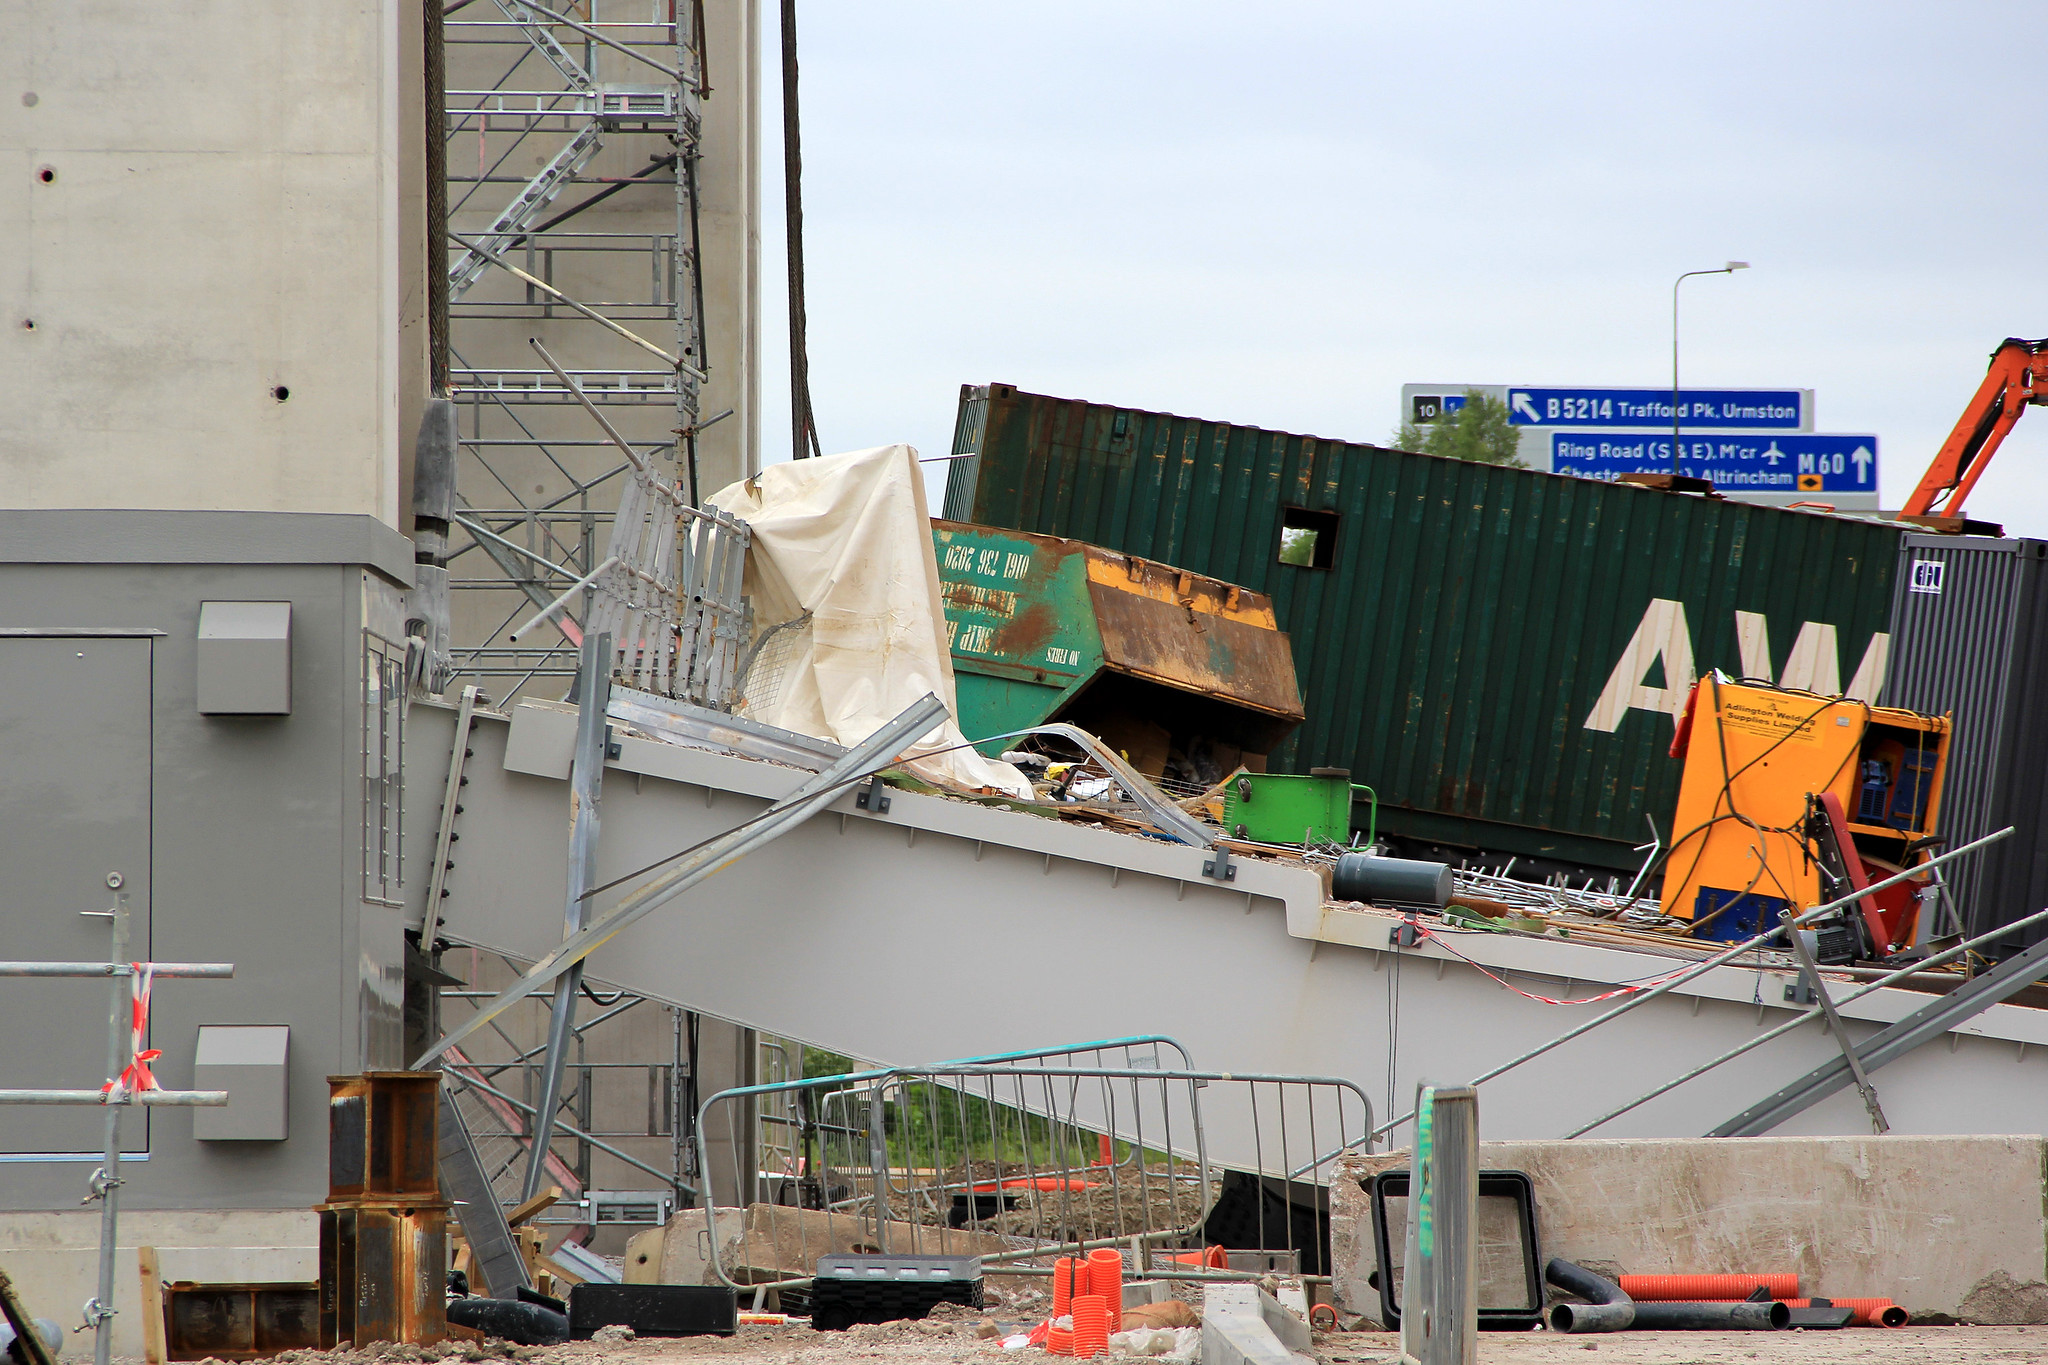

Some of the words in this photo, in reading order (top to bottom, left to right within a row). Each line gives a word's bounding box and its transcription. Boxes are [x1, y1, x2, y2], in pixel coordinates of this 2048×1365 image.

[1420, 405, 1436, 418] 10
[1547, 398, 1613, 420] B5214
[1617, 402, 1688, 418] Trafford
[1723, 403, 1796, 419] Urmston
[1558, 442, 1597, 460] Ring
[1600, 442, 1644, 459] Road
[1798, 453, 1845, 475] M60
[1701, 469, 1794, 485] Altrincham
[944, 545, 976, 572] 2020
[977, 549, 999, 577] 736
[1003, 552, 1030, 580] 0161
[960, 624, 994, 654] SKIP
[1045, 646, 1069, 664] FIRES
[1068, 650, 1081, 667] NO
[1725, 703, 1773, 717] Adlington
[1727, 712, 1770, 726] Supplies
